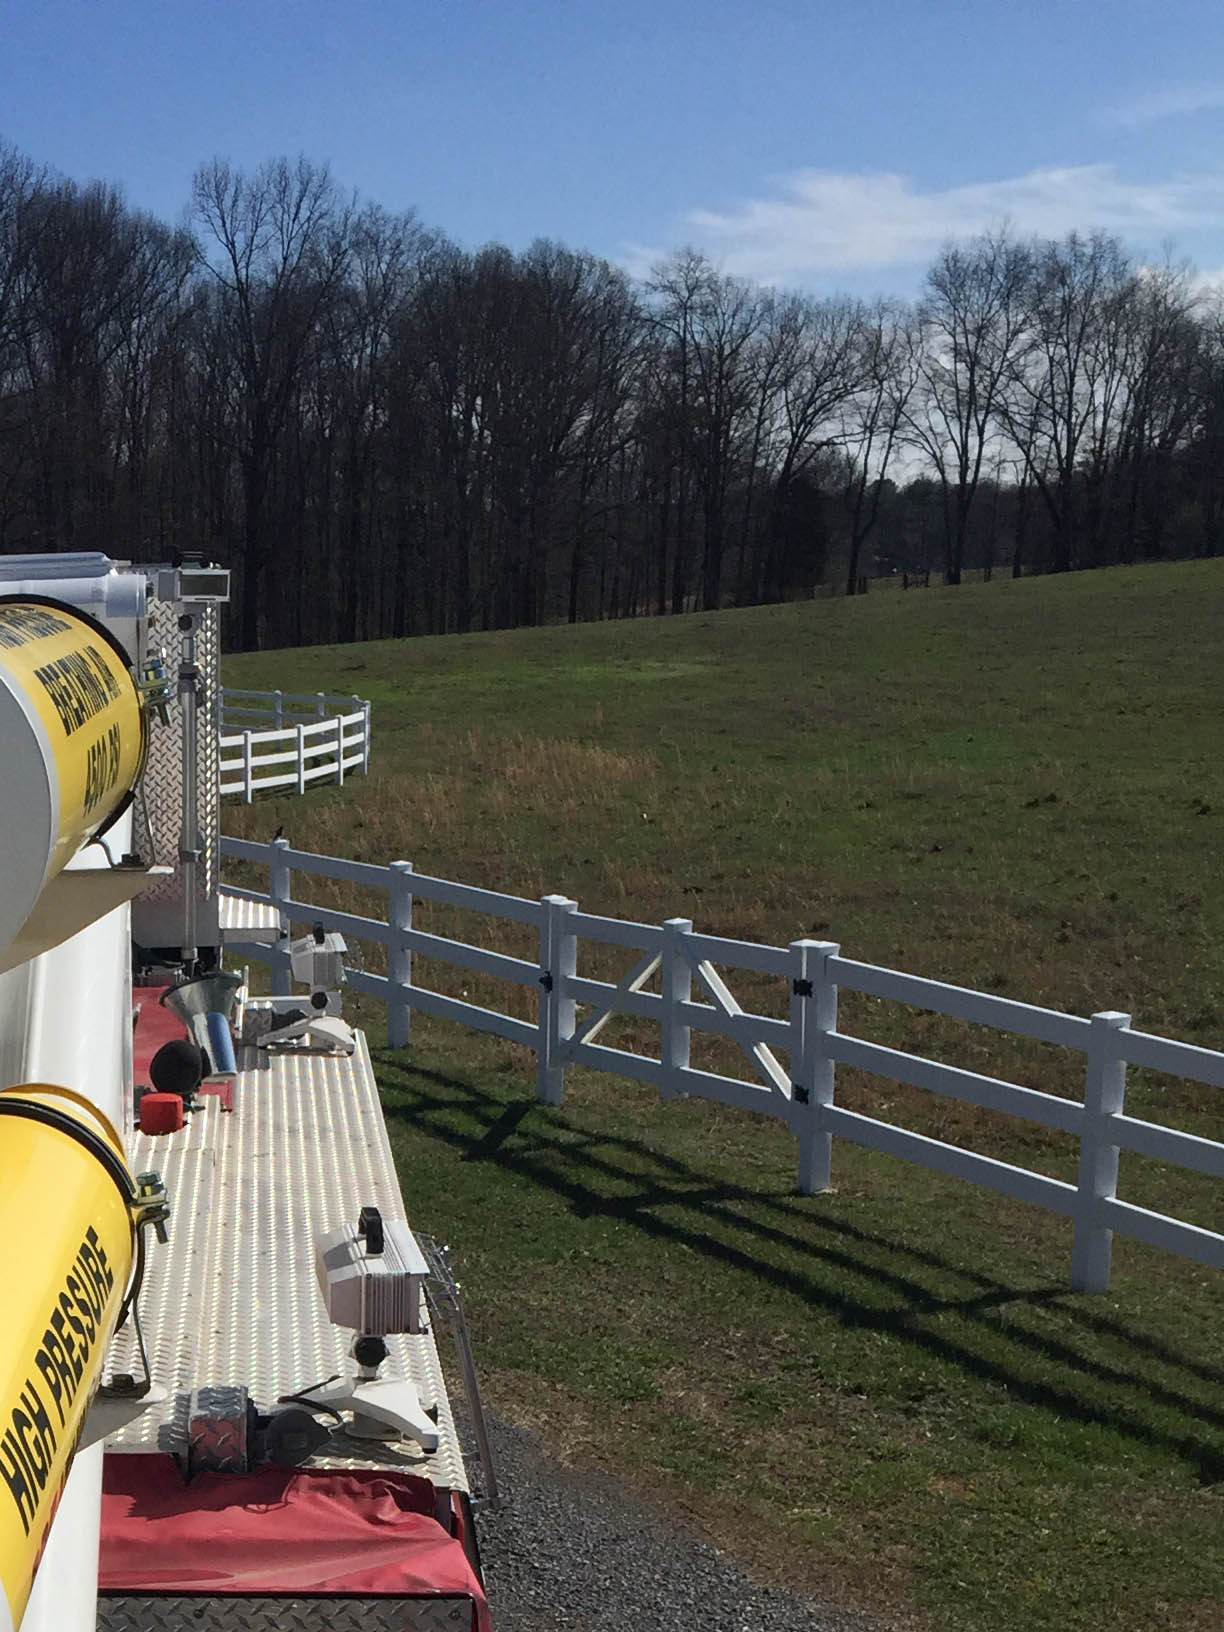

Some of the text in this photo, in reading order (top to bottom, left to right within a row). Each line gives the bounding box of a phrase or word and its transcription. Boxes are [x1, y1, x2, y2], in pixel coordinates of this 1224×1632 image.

[32, 645, 122, 737] BREATHING AIR
[35, 1225, 114, 1428] PRESSURE
